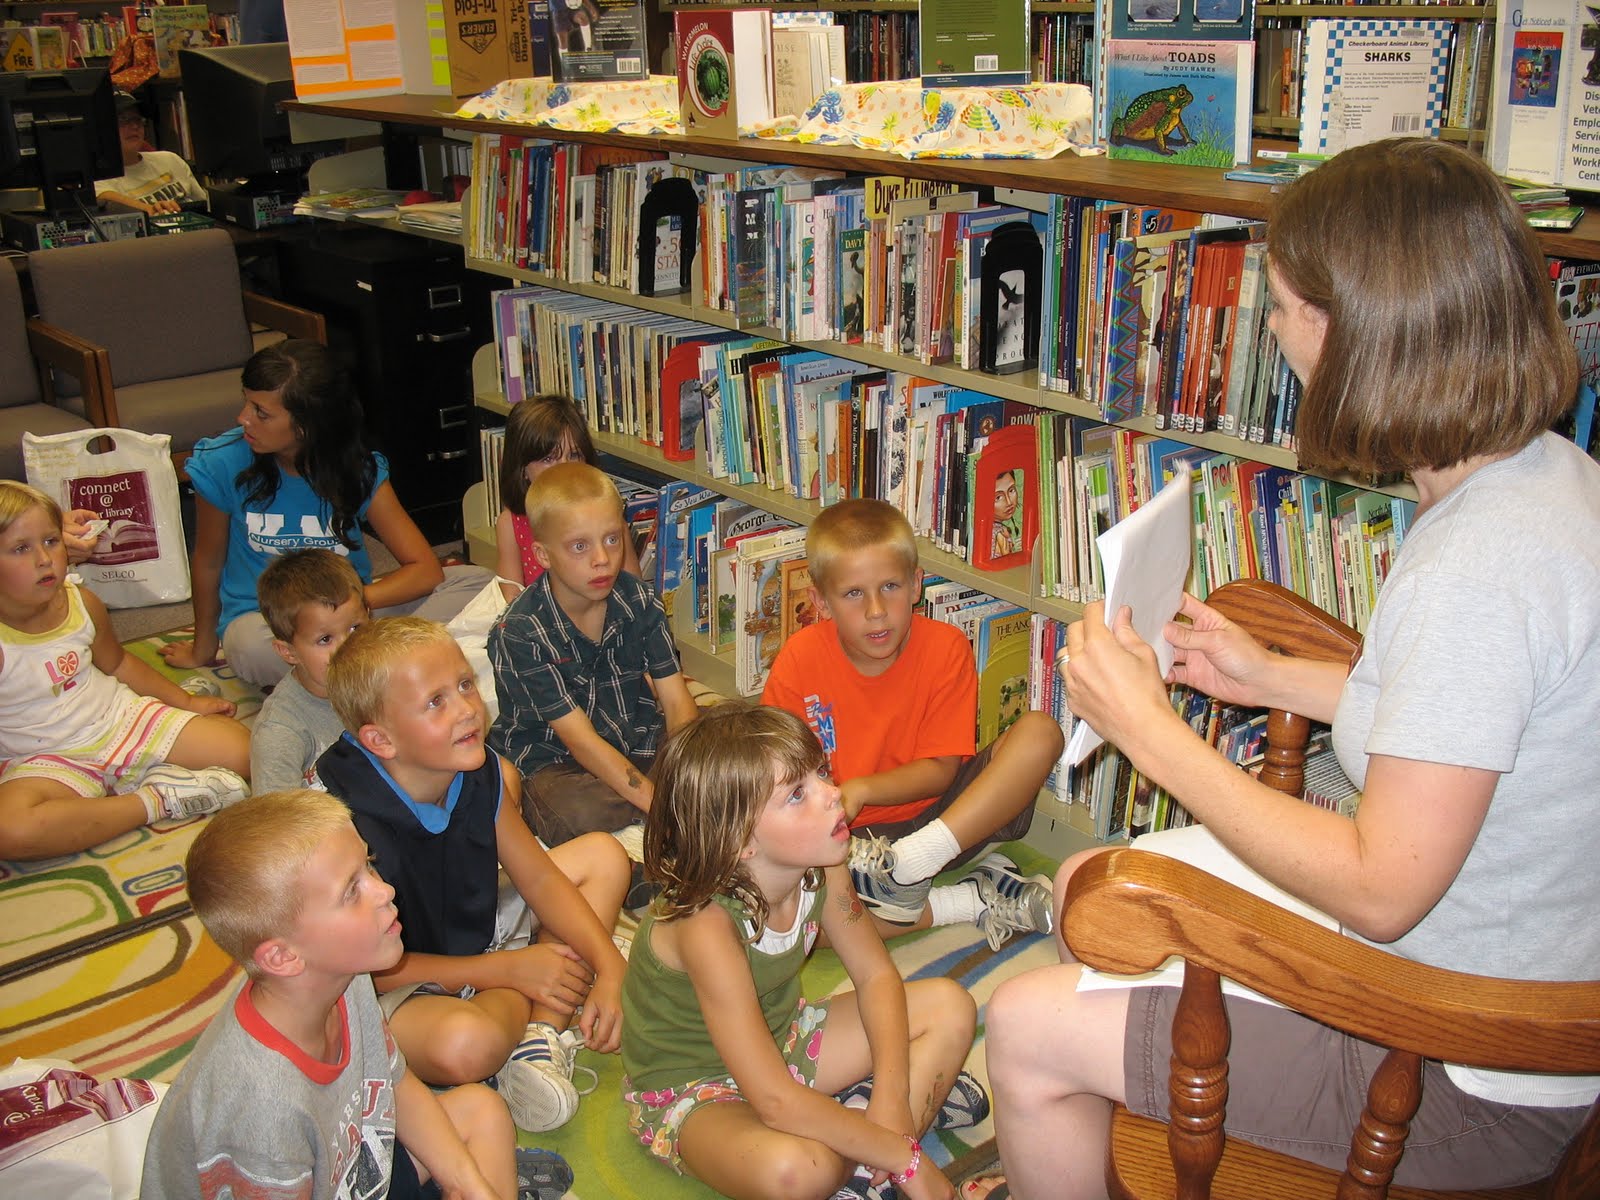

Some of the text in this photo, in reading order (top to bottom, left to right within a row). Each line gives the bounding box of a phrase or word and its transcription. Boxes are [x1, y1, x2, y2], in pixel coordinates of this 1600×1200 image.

[681, 22, 709, 60] WATERMELON
[1409, 40, 1430, 48] Library
[1168, 52, 1216, 64] TOADS
[1364, 52, 1411, 62] SHARKS
[79, 478, 131, 496] connect
[99, 494, 114, 507] @
[673, 502, 683, 510] So
[684, 497, 697, 508] You
[105, 506, 134, 519] library
[1392, 506, 1401, 532] INDIANS
[731, 512, 767, 536] George
[250, 533, 339, 547] Nursery Grou
[101, 569, 135, 580] SELCO
[996, 625, 1012, 636] THE
